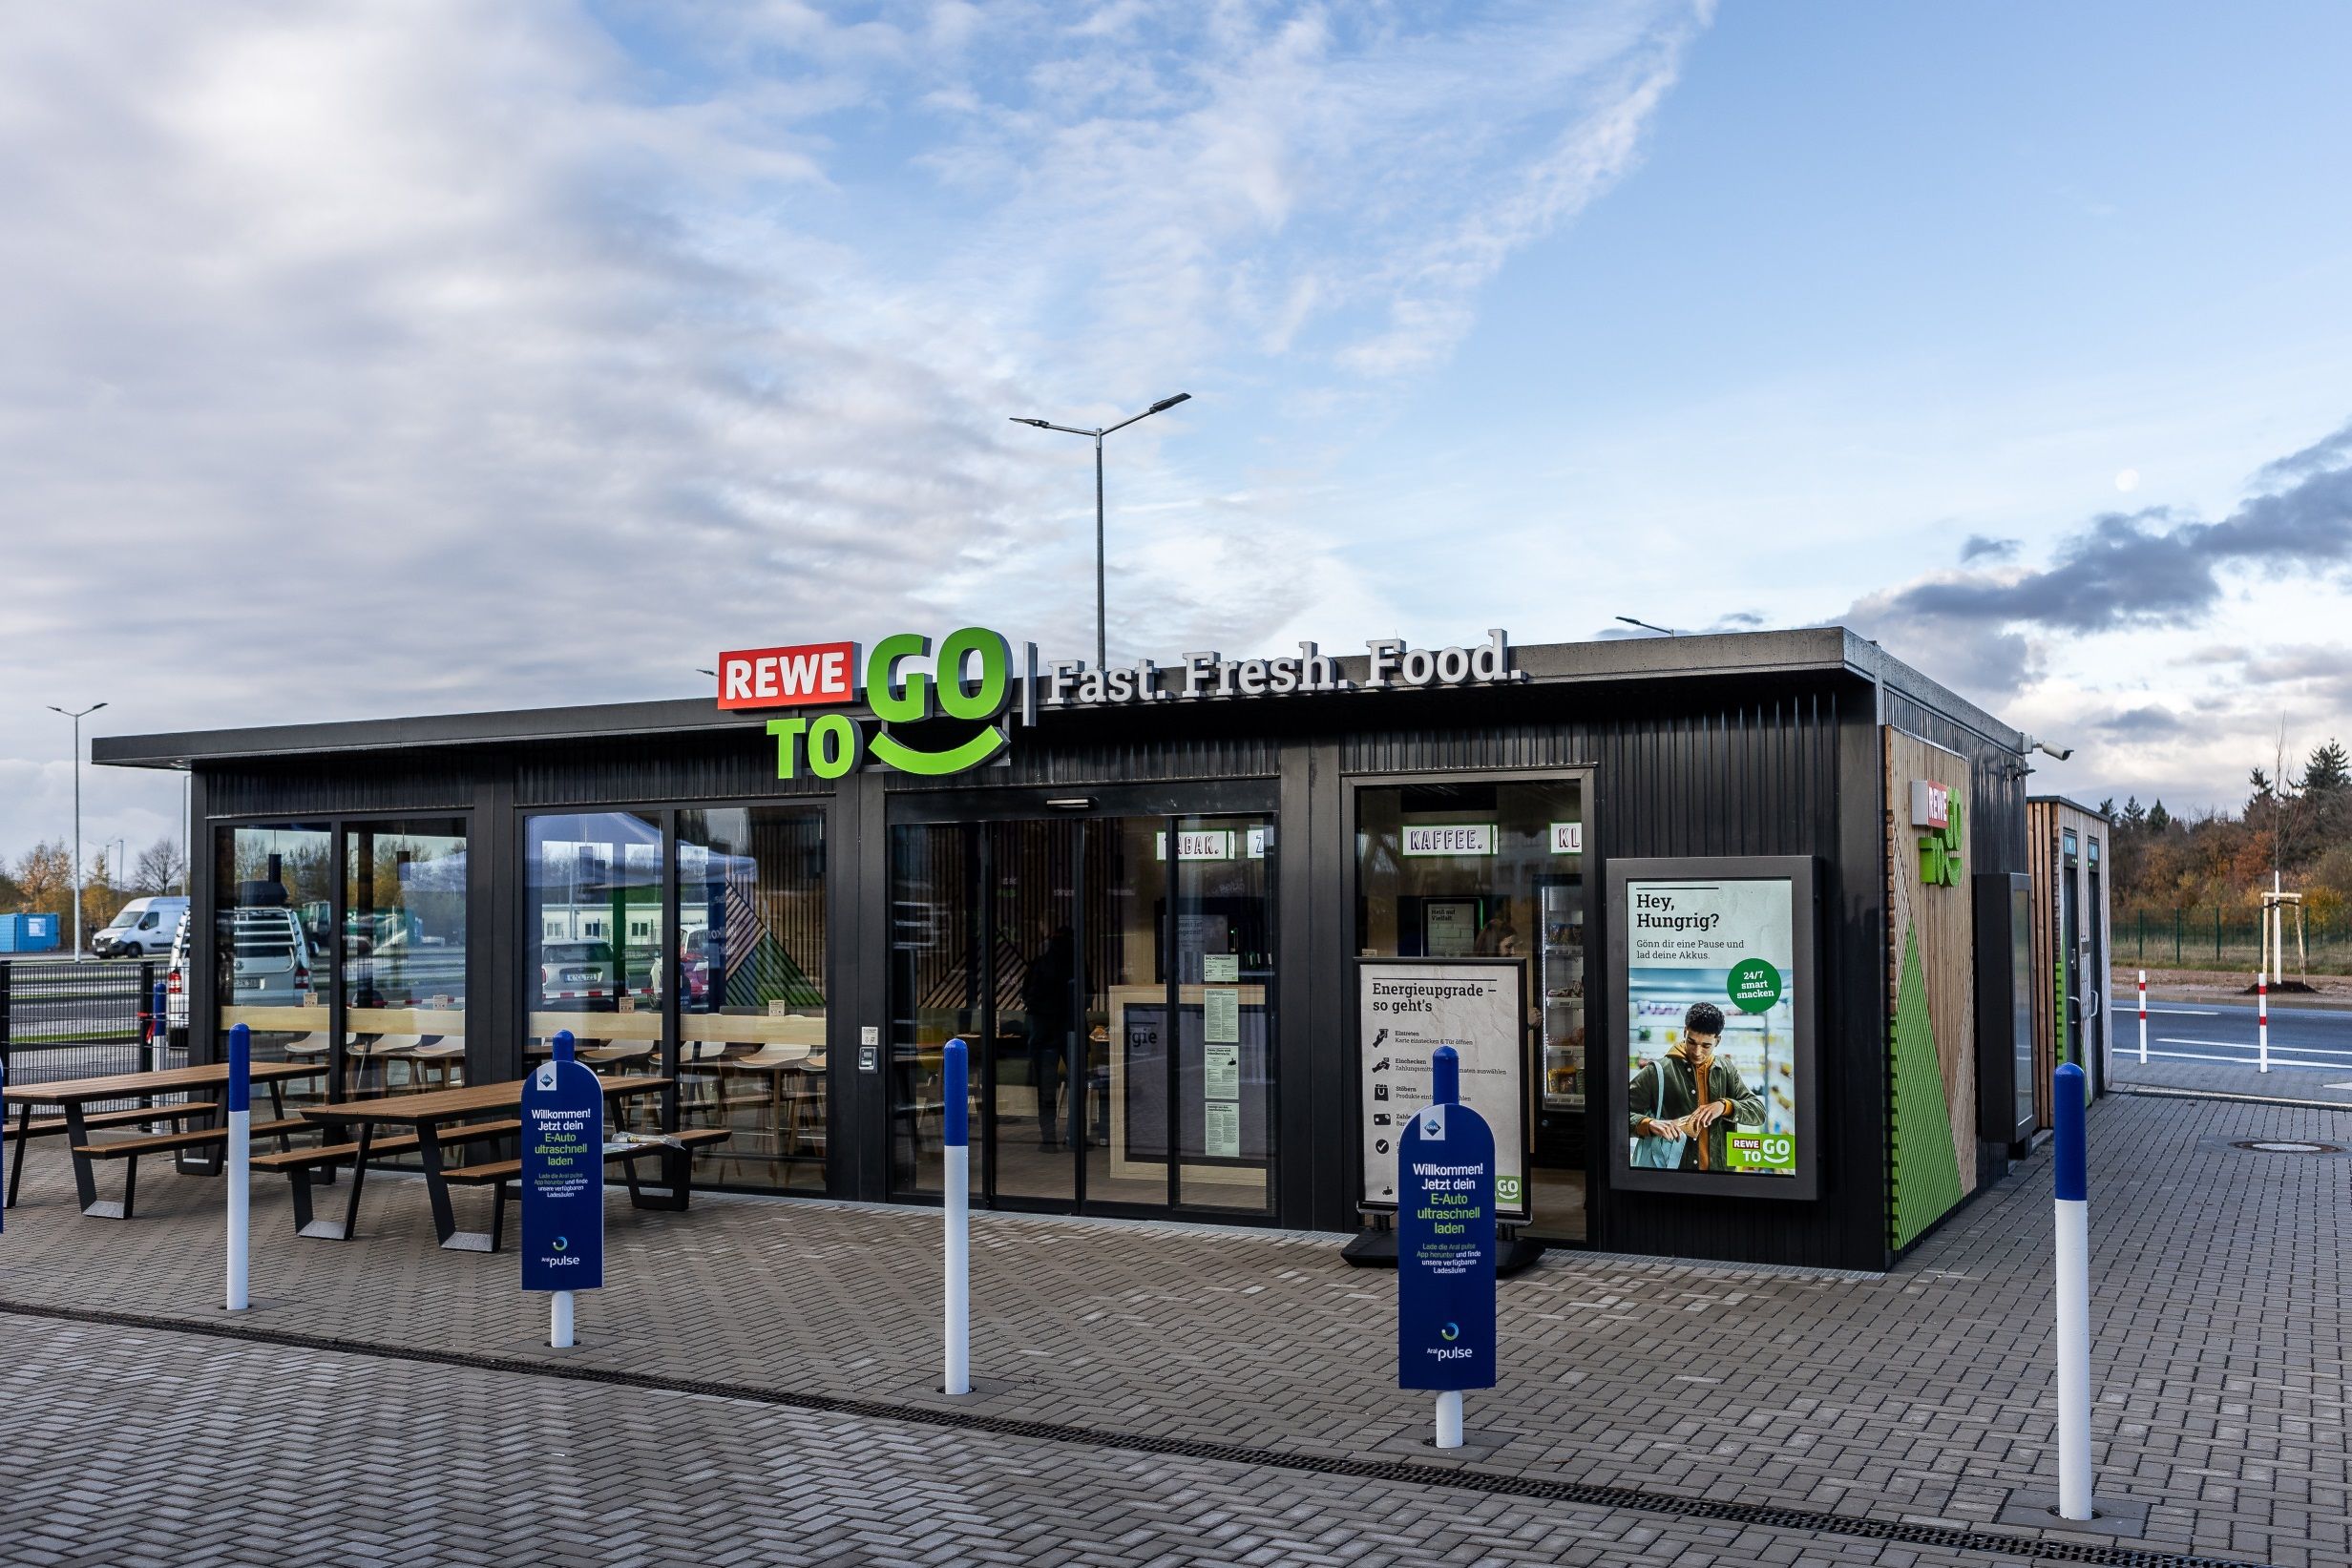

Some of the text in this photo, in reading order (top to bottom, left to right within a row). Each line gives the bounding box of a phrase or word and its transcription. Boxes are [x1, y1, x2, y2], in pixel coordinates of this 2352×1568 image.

[1048, 628, 1523, 704] Fast. Fresh. Food.
[726, 652, 846, 700] REWE
[867, 627, 1010, 722] GO
[766, 714, 857, 780] TO
[1928, 786, 1947, 822] REWE
[1165, 836, 1220, 854] ABAK.
[1410, 829, 1483, 850] KAFFEE.
[1636, 893, 1675, 911] Hey,
[1636, 912, 1719, 931] Hungrig?
[1636, 940, 1744, 949] Gönn dir eine Pause und
[1636, 951, 1711, 960] lad deine Akkus.
[1743, 971, 1764, 980] 24/7
[1373, 983, 1483, 999] Energieupgrade
[1741, 980, 1768, 990] smart
[1736, 989, 1774, 999] snacken
[1373, 999, 1433, 1014] so geht's
[531, 1108, 591, 1119] Willkommen!
[537, 1120, 583, 1131] Jetzt dein
[545, 1133, 577, 1142] E-Auto
[535, 1143, 588, 1154] ultraschnell
[1733, 1139, 1760, 1149] REWE
[1762, 1139, 1791, 1156] GO
[548, 1156, 574, 1166] laden
[1742, 1150, 1762, 1162] TO
[1413, 1162, 1483, 1176] Willkommen!
[1421, 1178, 1476, 1190] Jetzt dein
[1497, 1180, 1520, 1193] GO
[1431, 1193, 1468, 1204] E-Auto
[1418, 1206, 1480, 1220] ultraschnell
[1435, 1223, 1465, 1234] laden
[1417, 1250, 1429, 1259] App
[550, 1255, 580, 1267] pulse
[1438, 1346, 1473, 1362] pulse
